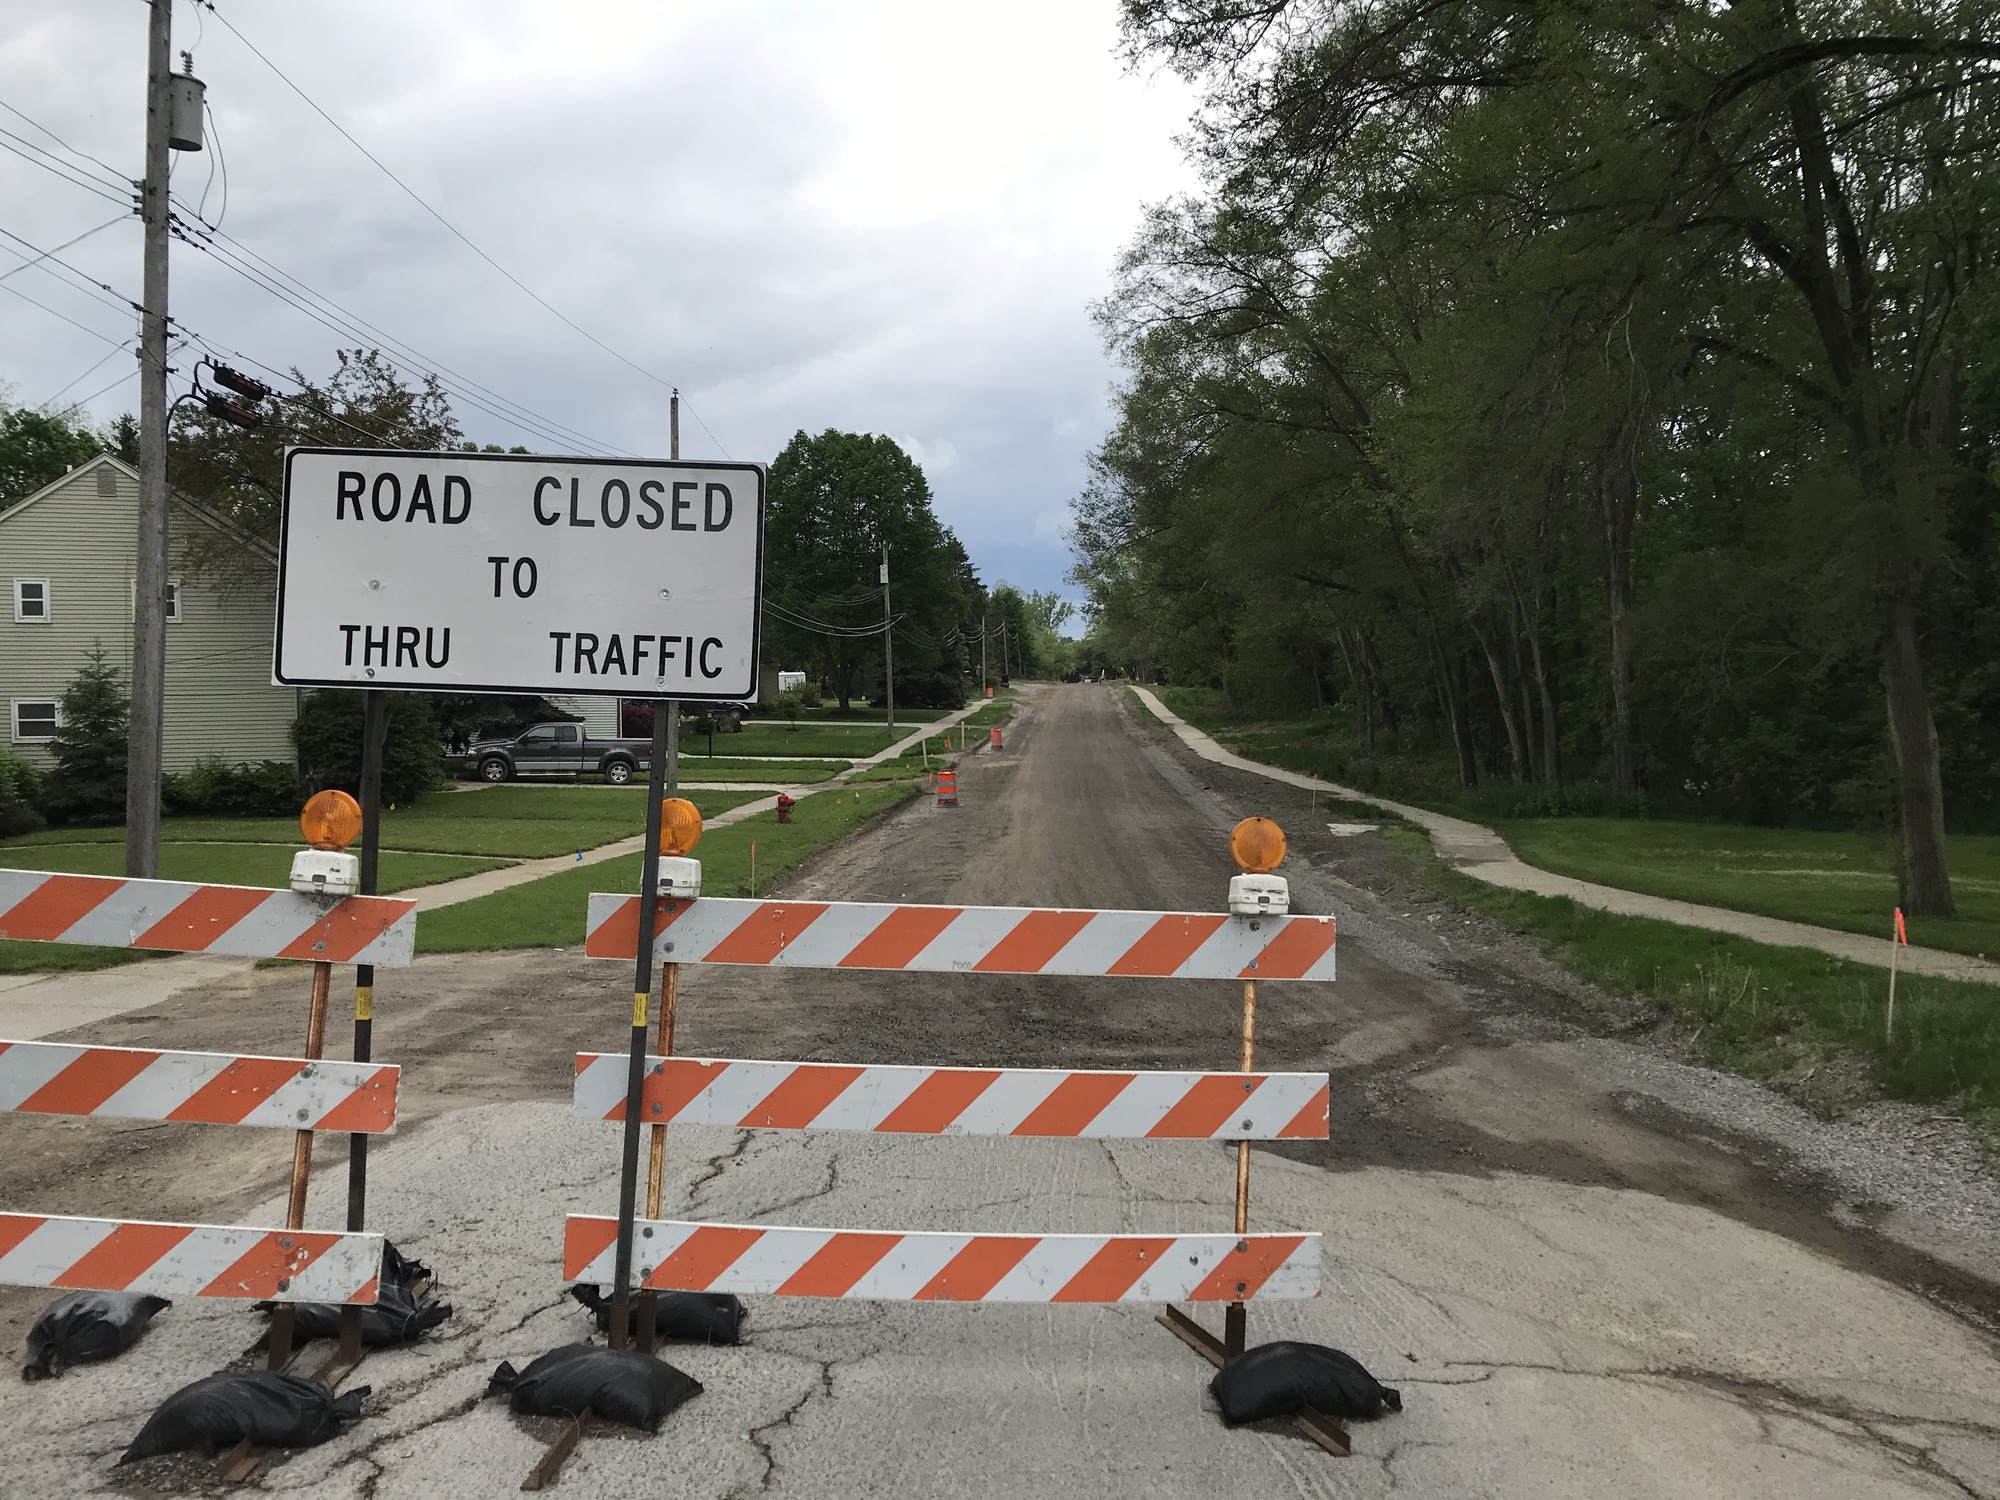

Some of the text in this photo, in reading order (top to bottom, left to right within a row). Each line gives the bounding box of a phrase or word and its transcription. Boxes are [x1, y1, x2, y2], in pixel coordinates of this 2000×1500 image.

[336, 470, 733, 532] ROAD CLOSED
[487, 556, 538, 599] TO
[339, 624, 724, 679] THRU TRAFFIC
